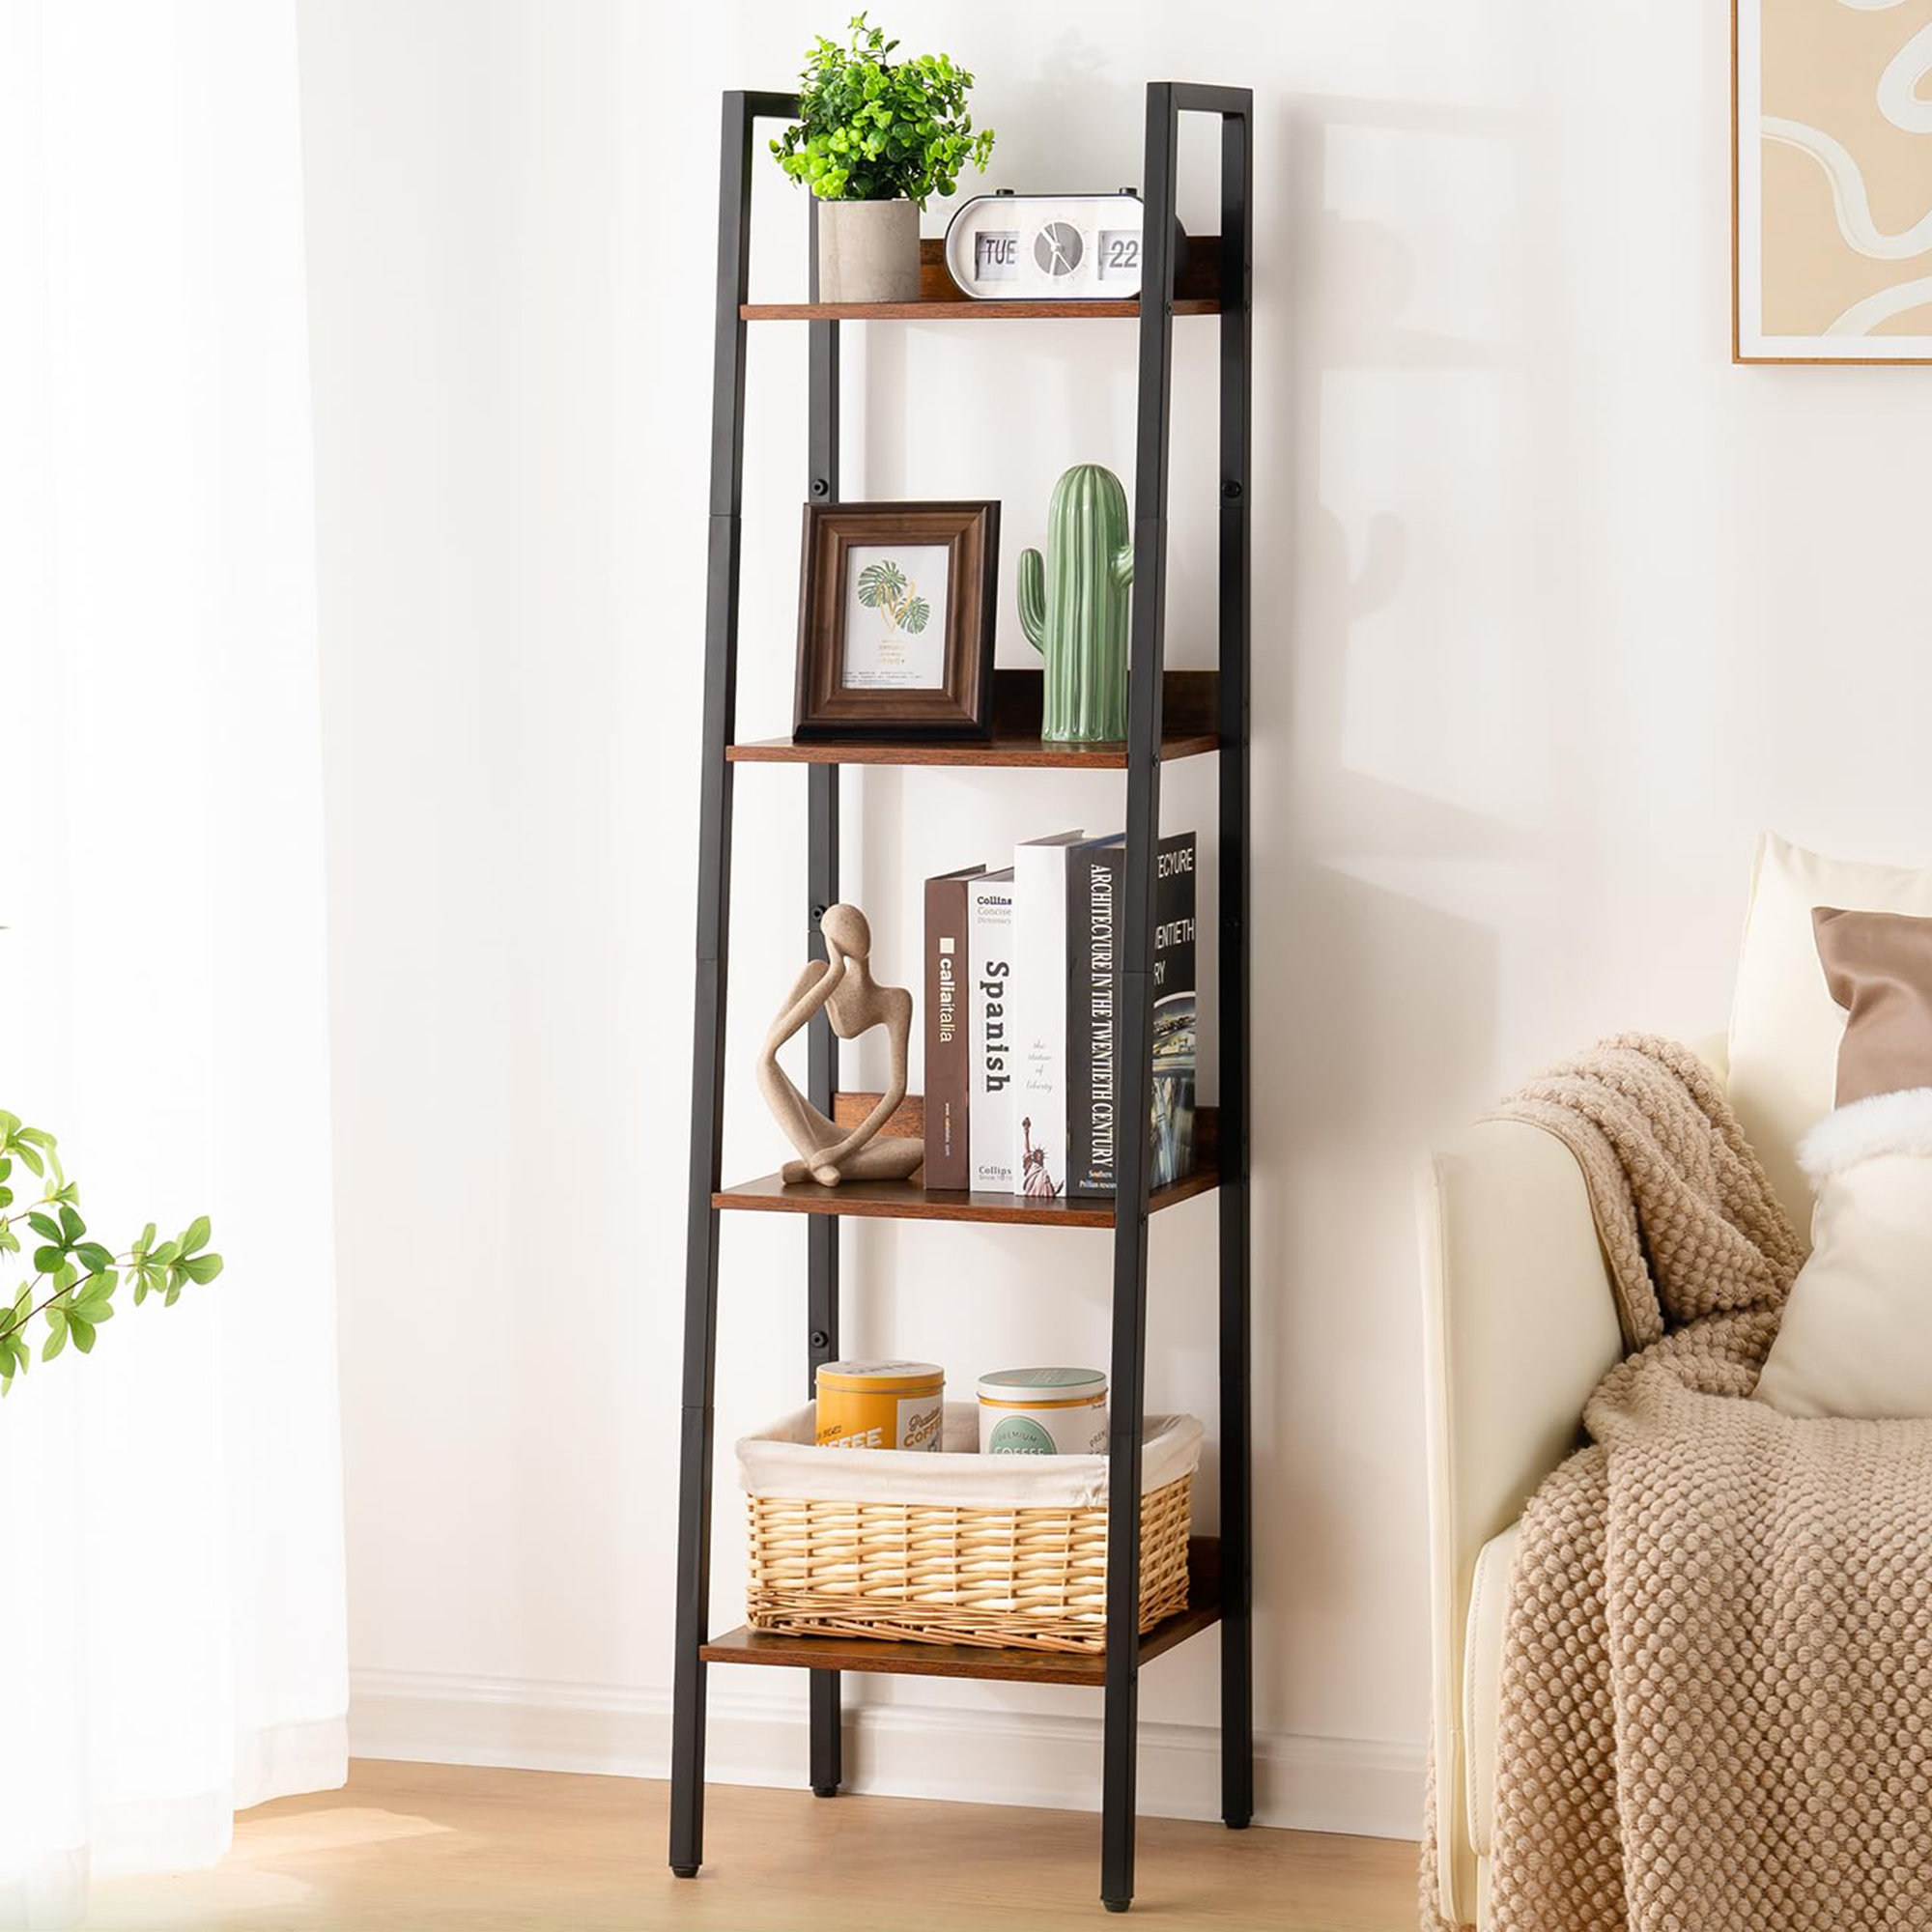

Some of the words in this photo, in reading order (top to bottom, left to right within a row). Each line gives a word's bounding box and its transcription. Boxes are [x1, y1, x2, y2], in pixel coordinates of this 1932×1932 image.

[985, 240, 1018, 265] TUE
[1110, 240, 1139, 269] 22
[1157, 848, 1194, 878] ECYURE
[977, 895, 1012, 906] Collins
[1090, 864, 1113, 970] ARCHITECYURE
[1091, 973, 1113, 987] IN
[1091, 990, 1113, 1018] THE
[980, 960, 1010, 1094] Spanish
[1091, 1020, 1114, 1100] TWENTIETH
[1091, 1102, 1114, 1168] CENTURY
[998, 1430, 1037, 1444] PREMIUM
